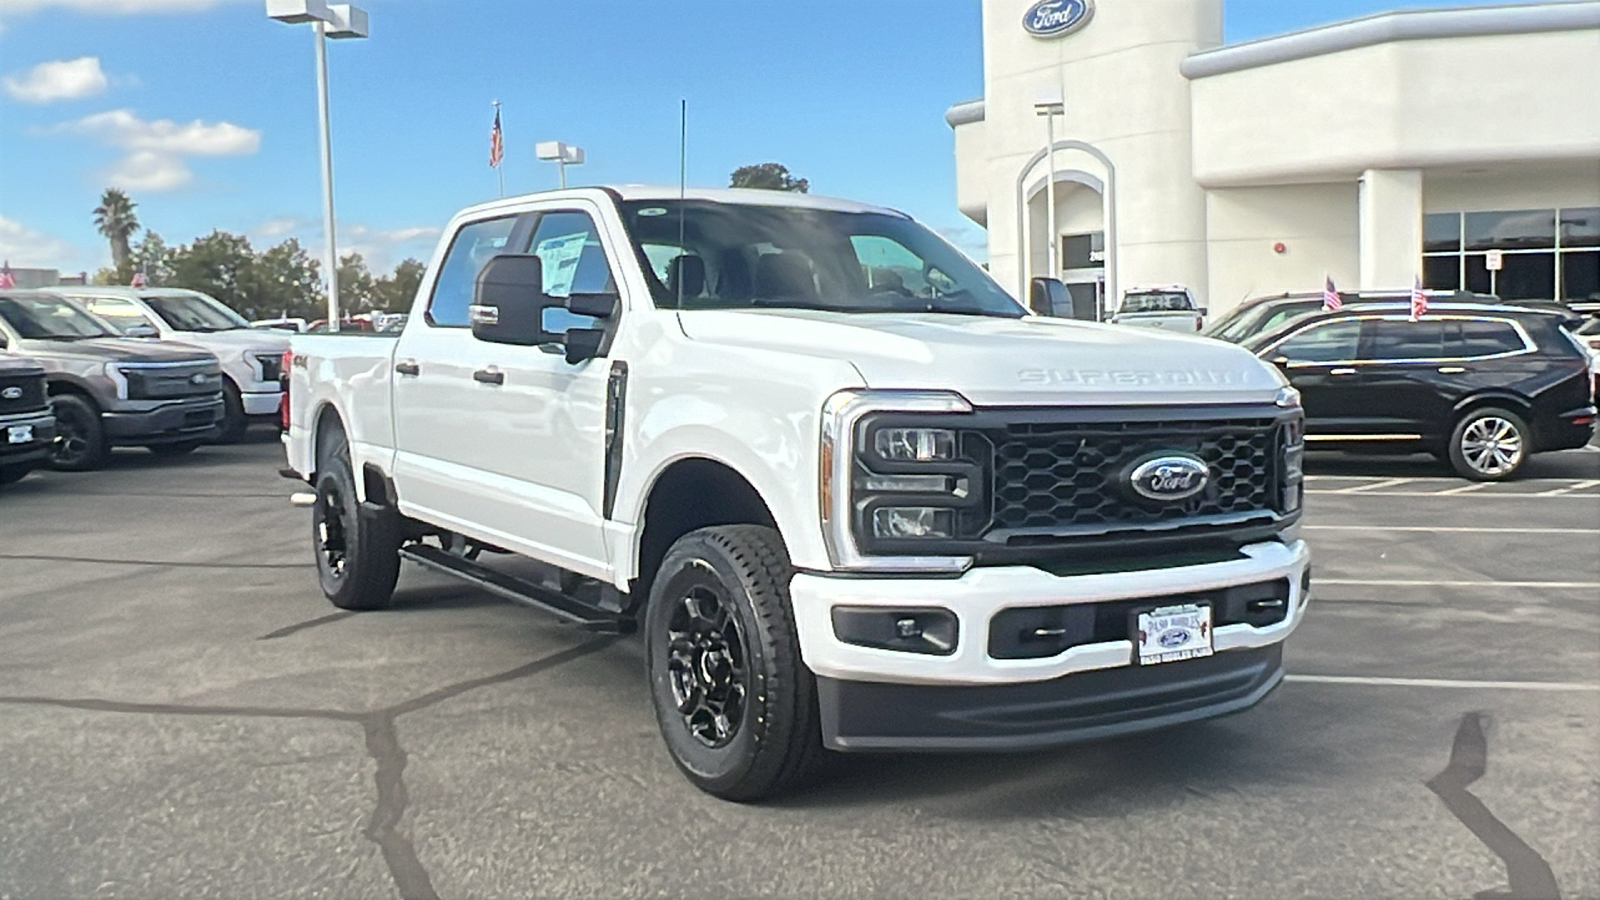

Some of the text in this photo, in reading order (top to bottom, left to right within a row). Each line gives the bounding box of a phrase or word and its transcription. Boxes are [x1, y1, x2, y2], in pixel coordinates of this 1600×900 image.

[1033, 2, 1073, 29] Ford
[1018, 368, 1161, 387] SUPER
[1151, 466, 1194, 491] Ford
